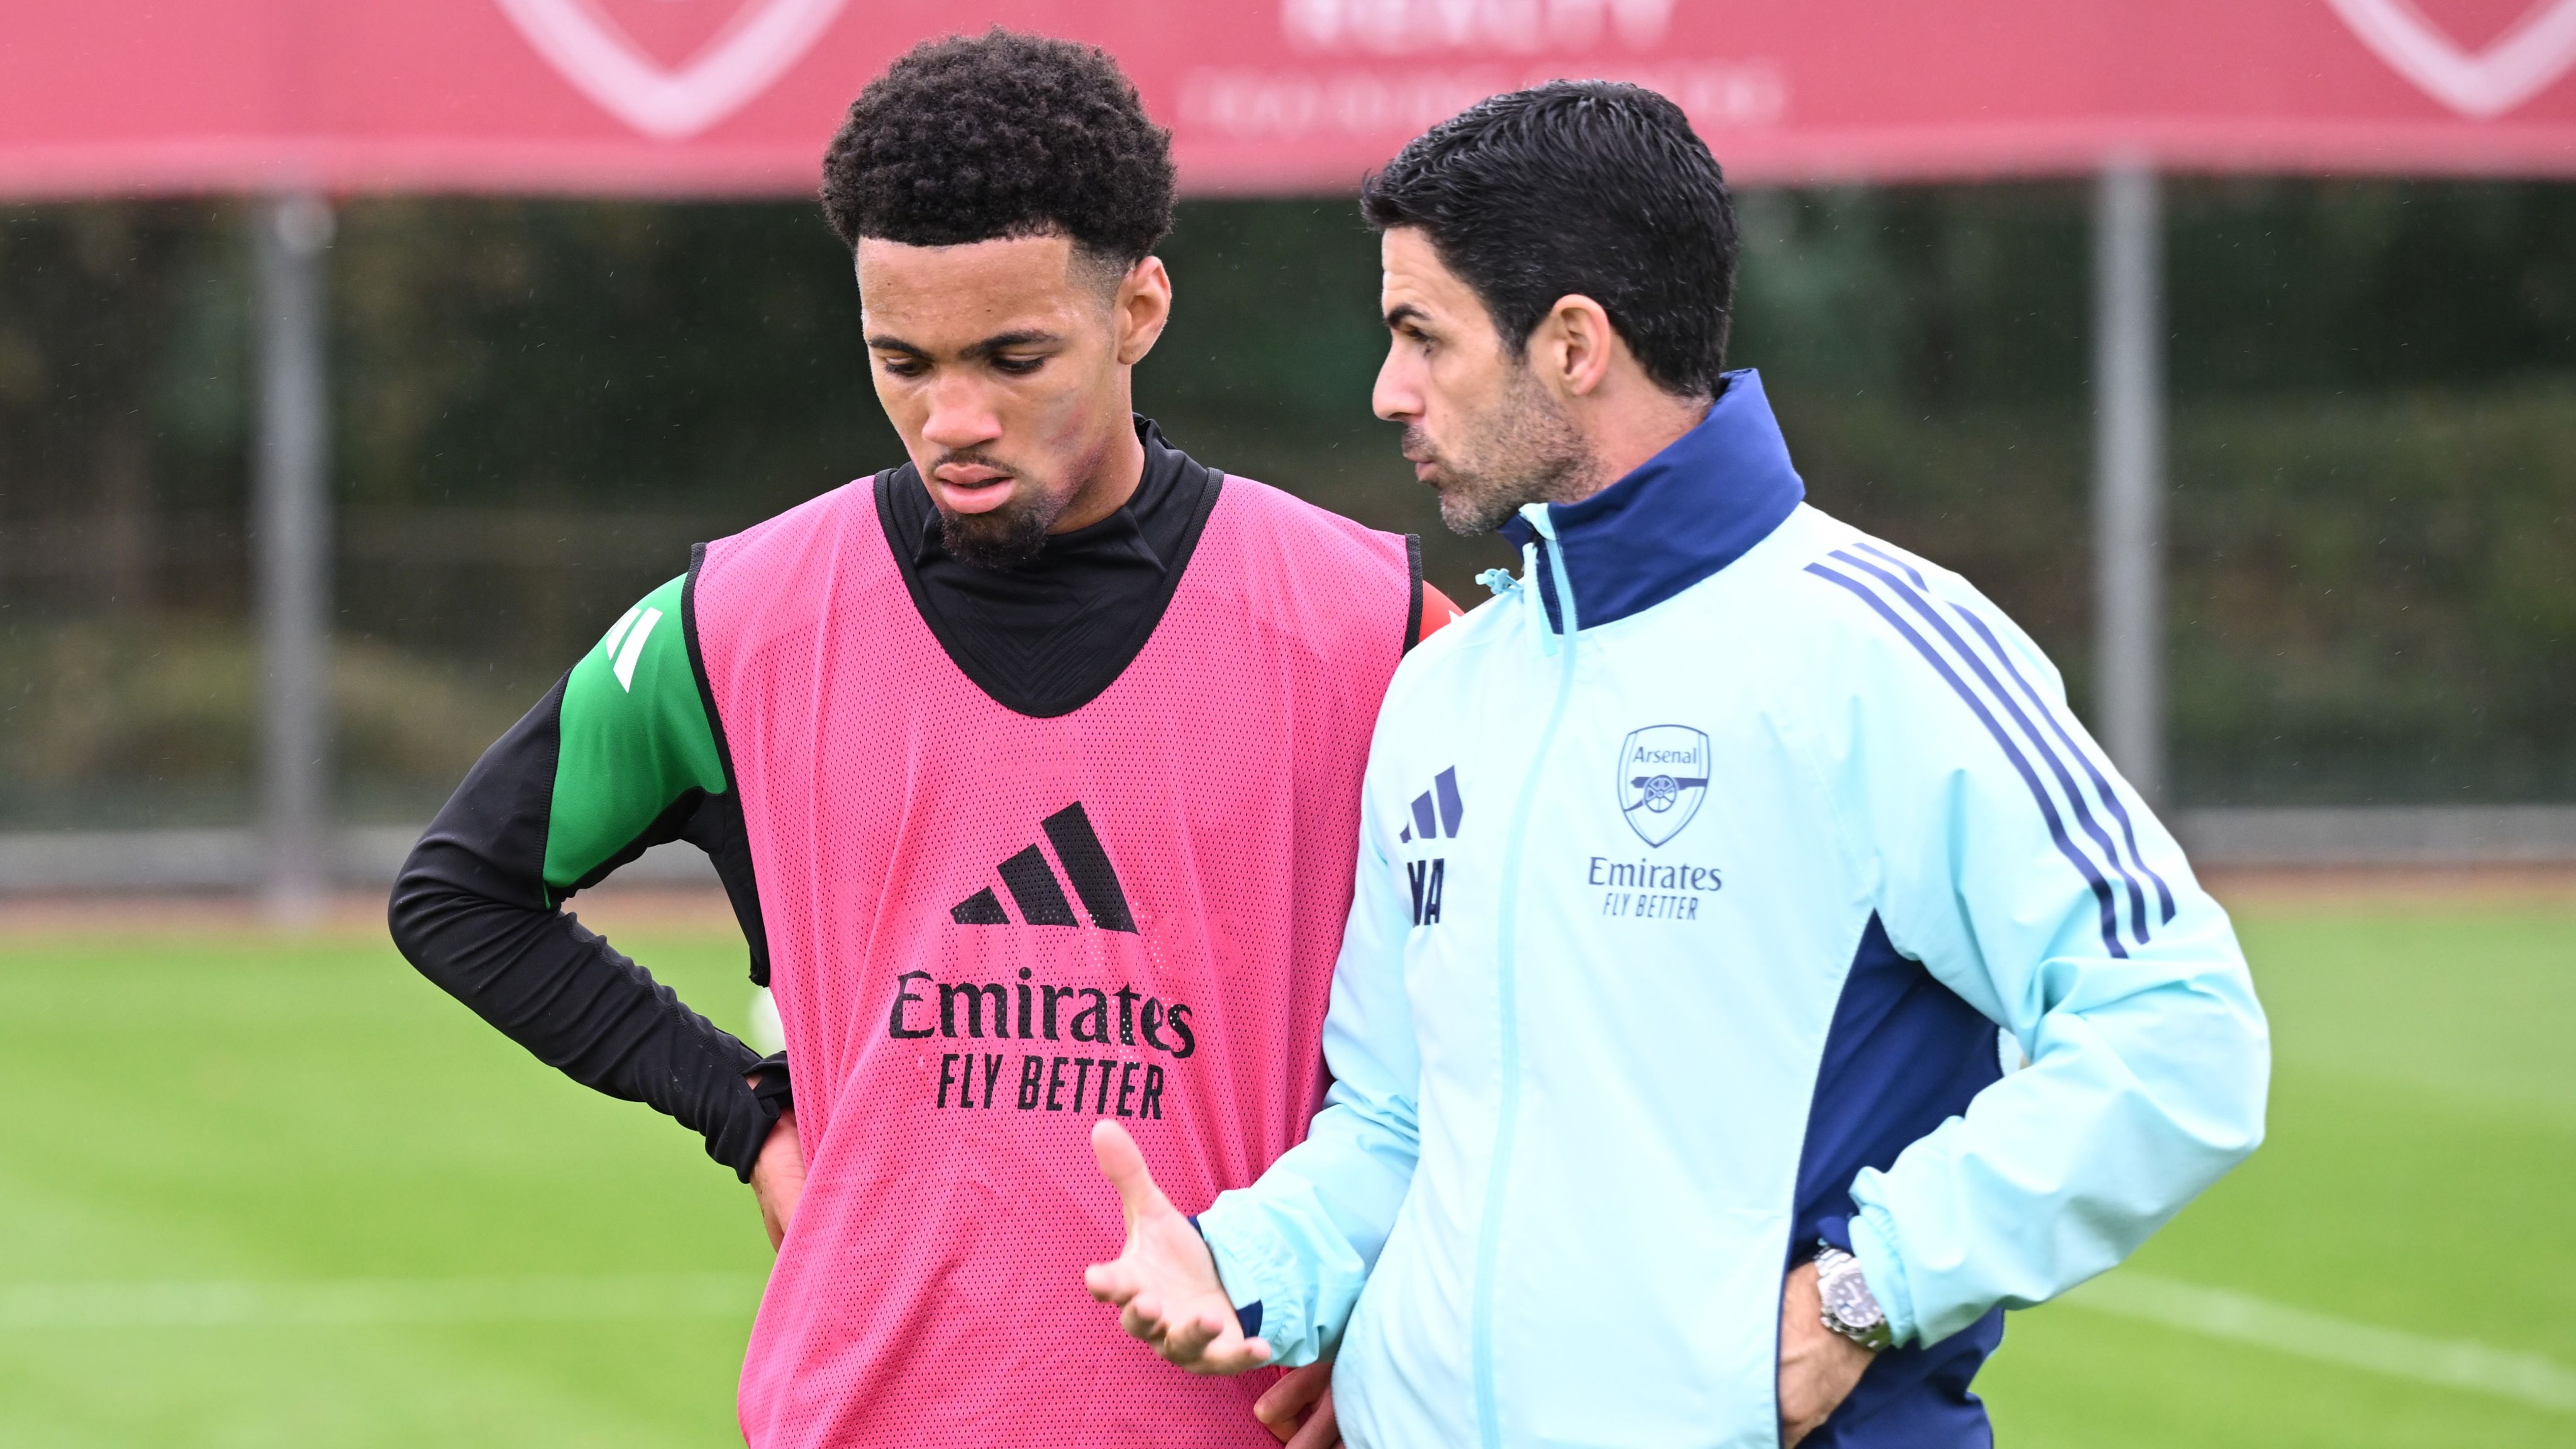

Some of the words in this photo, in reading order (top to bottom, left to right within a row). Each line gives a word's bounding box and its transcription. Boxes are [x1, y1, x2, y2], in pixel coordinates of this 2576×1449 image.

[1633, 746, 1697, 764] Arsenal
[1588, 856, 1723, 892] Emirates
[1602, 892, 1631, 916] FLY
[1635, 894, 1699, 921] BETTER
[889, 966, 1196, 1059] Emirates
[937, 1053, 1004, 1109] FLY
[1016, 1055, 1163, 1120] BETTER
